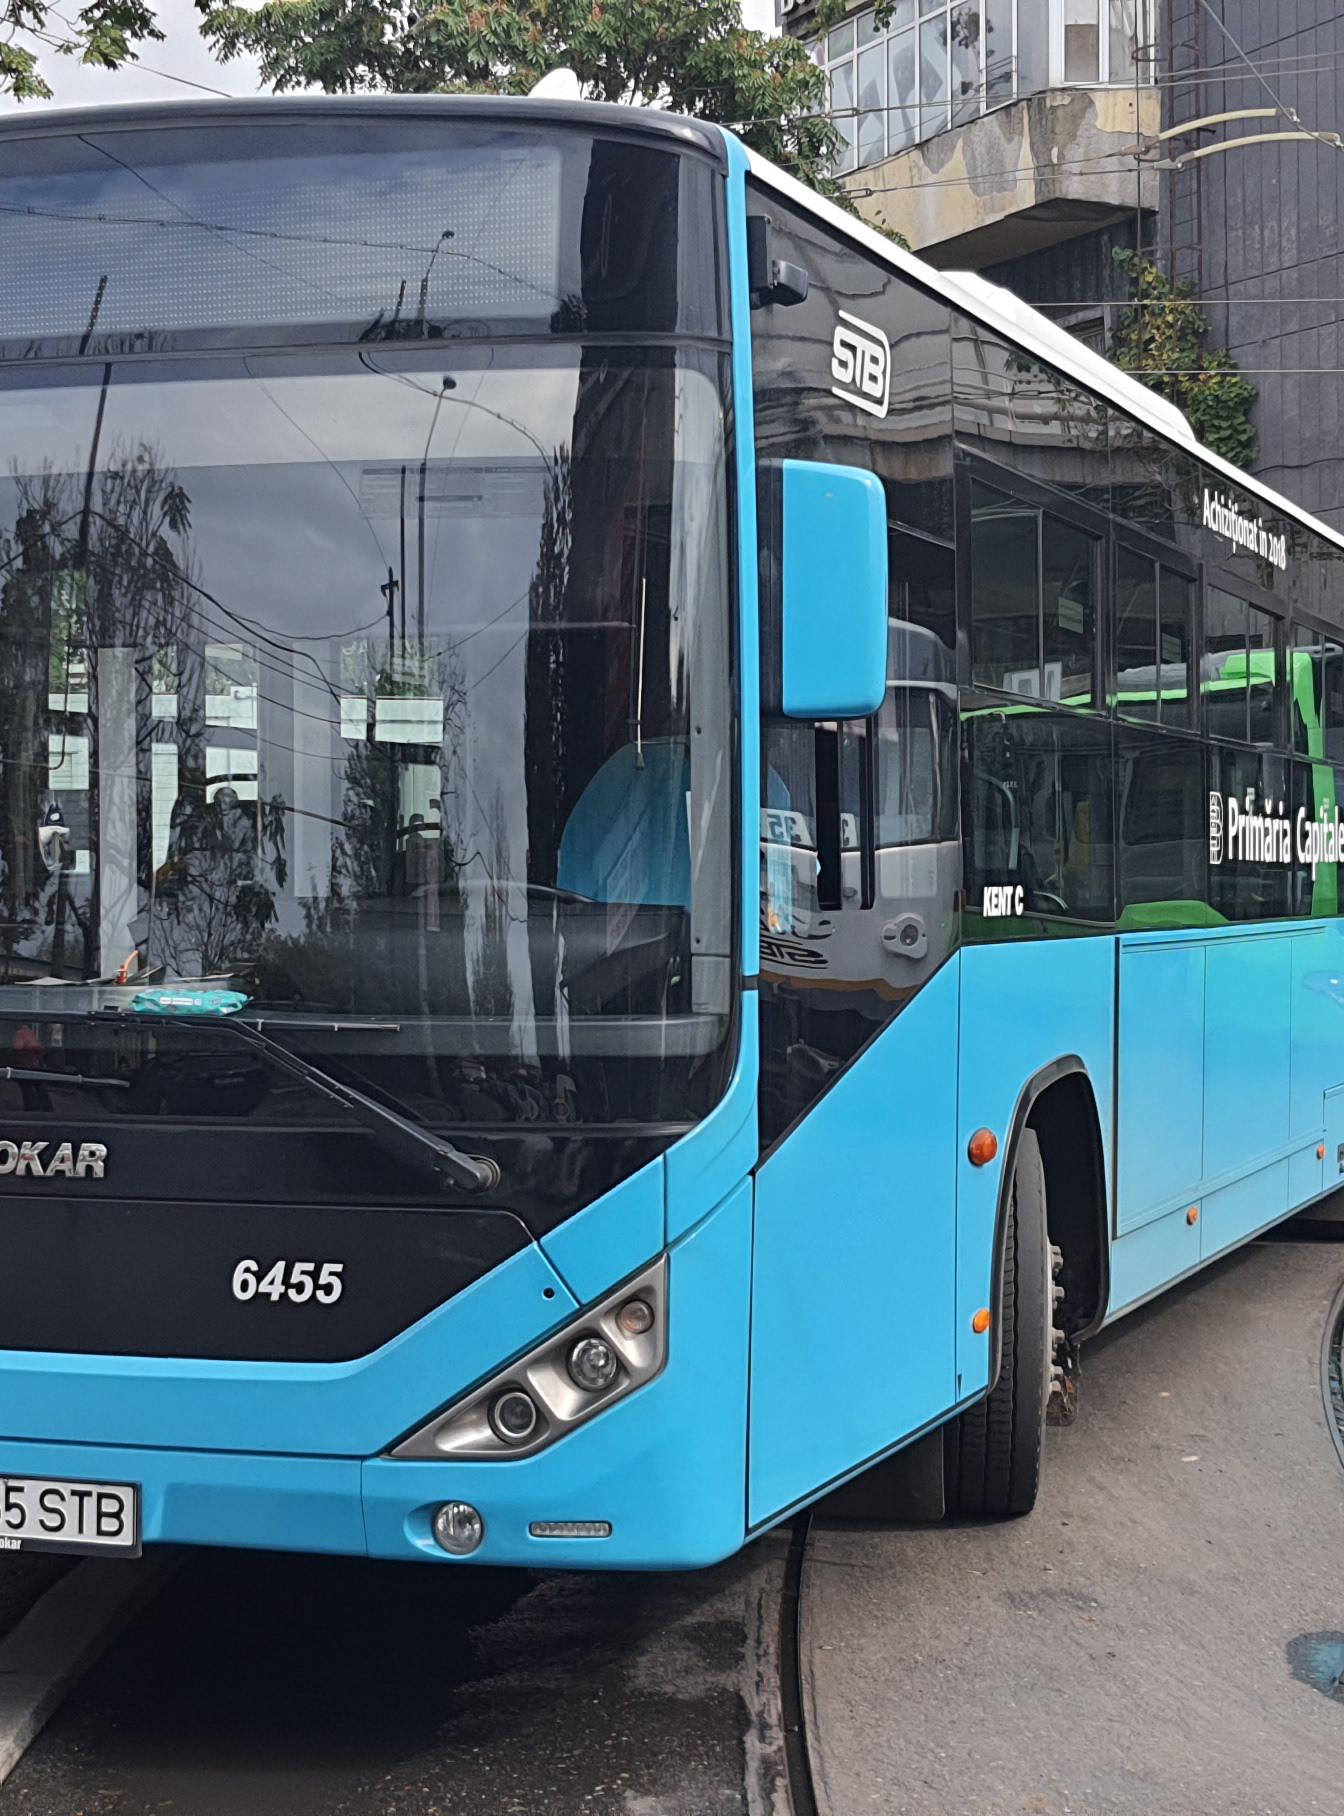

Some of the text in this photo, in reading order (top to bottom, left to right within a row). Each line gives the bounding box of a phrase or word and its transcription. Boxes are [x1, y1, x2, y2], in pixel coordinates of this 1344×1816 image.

[830, 325, 886, 399] STB
[1268, 534, 1286, 571] 2018
[1228, 797, 1291, 864] Primăria
[983, 885, 1024, 917] KENT C
[232, 1259, 344, 1304] 6455
[38, 1487, 125, 1537] STB
